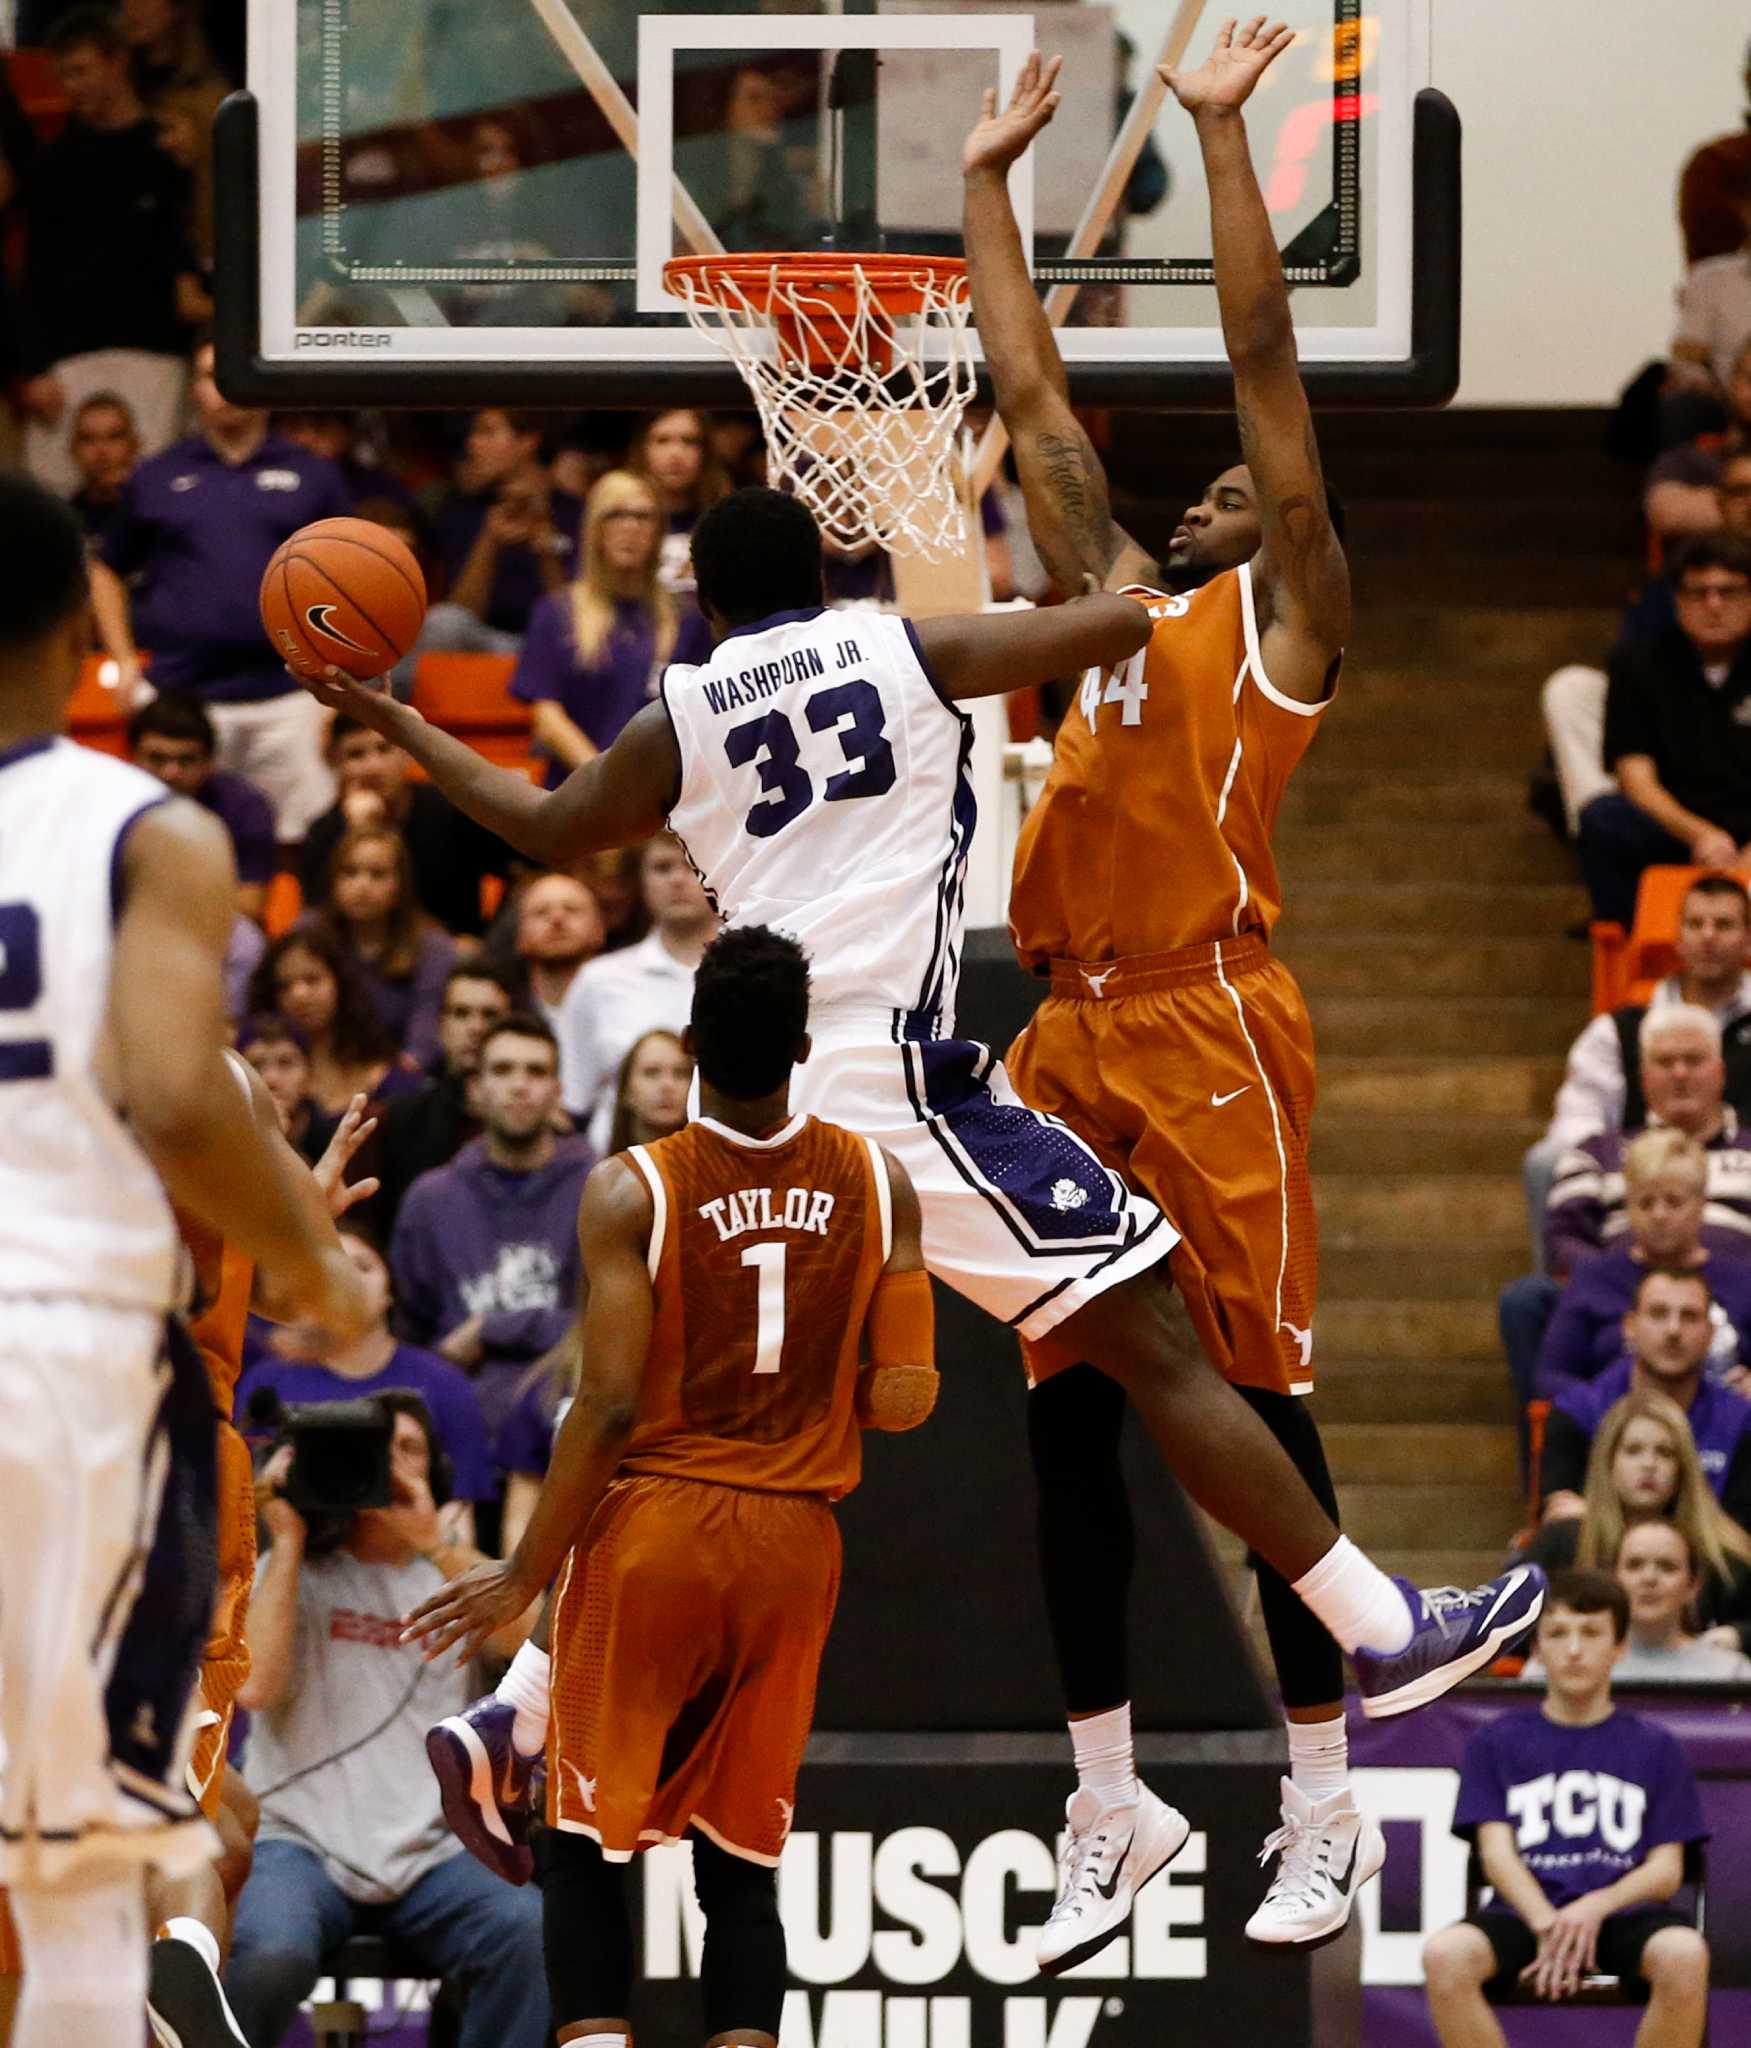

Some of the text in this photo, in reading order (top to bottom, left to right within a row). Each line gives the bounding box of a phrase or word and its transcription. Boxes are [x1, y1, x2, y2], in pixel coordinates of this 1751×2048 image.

[702, 639, 870, 715] WASHBURN JR.
[1080, 646, 1149, 727] 44
[723, 678, 897, 838] 33
[698, 1187, 836, 1242] TAYLOR
[741, 1242, 787, 1374] 1
[1506, 1768, 1647, 1853] TCU
